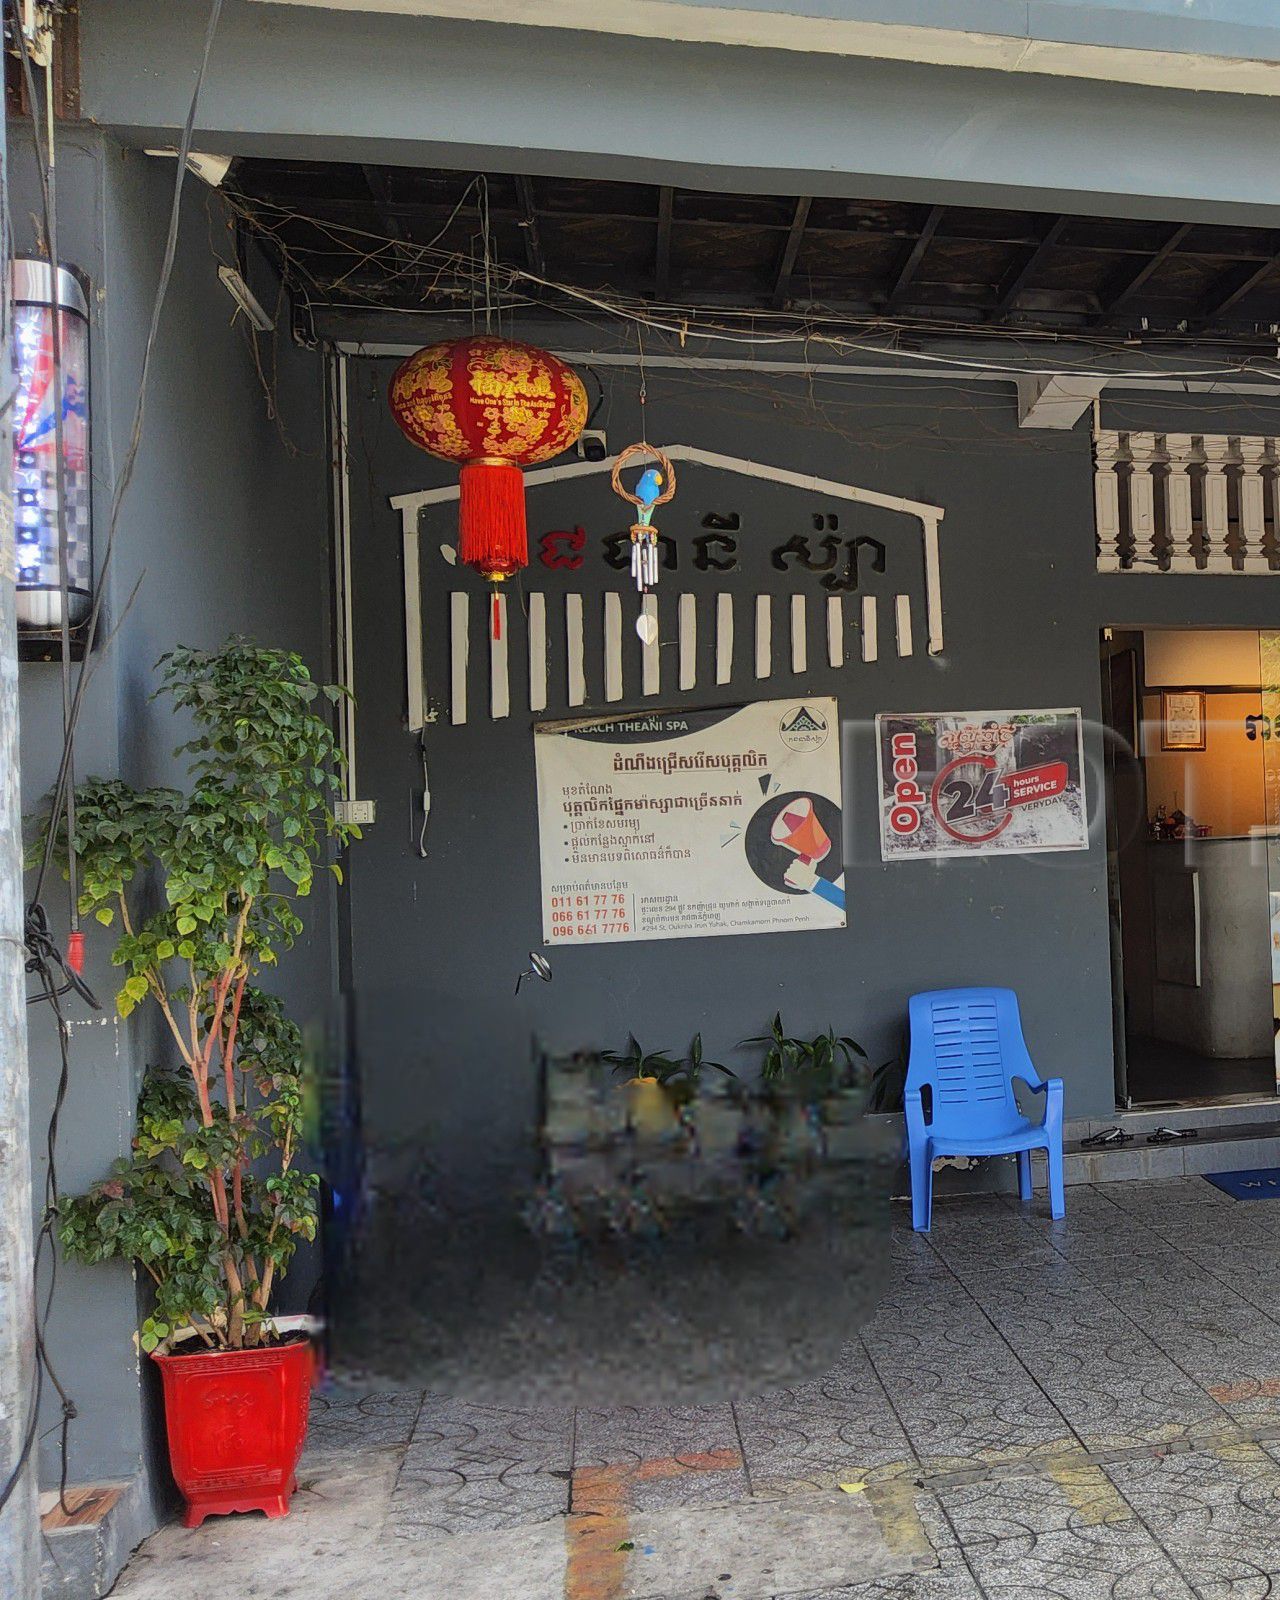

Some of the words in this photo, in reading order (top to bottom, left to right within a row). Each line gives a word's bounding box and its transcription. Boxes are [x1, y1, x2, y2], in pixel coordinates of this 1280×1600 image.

[619, 720, 662, 733] THEANI
[666, 720, 689, 732] SPA
[891, 733, 926, 835] Open
[1013, 776, 1040, 788] hours
[1013, 780, 1057, 799] SERVICE
[943, 769, 1010, 824] 24
[551, 897, 572, 908] 011
[576, 896, 589, 906] 61
[594, 894, 607, 905] 77
[611, 893, 625, 904] 76
[552, 911, 573, 922] 066
[577, 910, 590, 921] 61
[594, 909, 608, 920] 77
[612, 908, 625, 919] 76
[552, 925, 574, 937] 096
[602, 922, 630, 934] 7776
